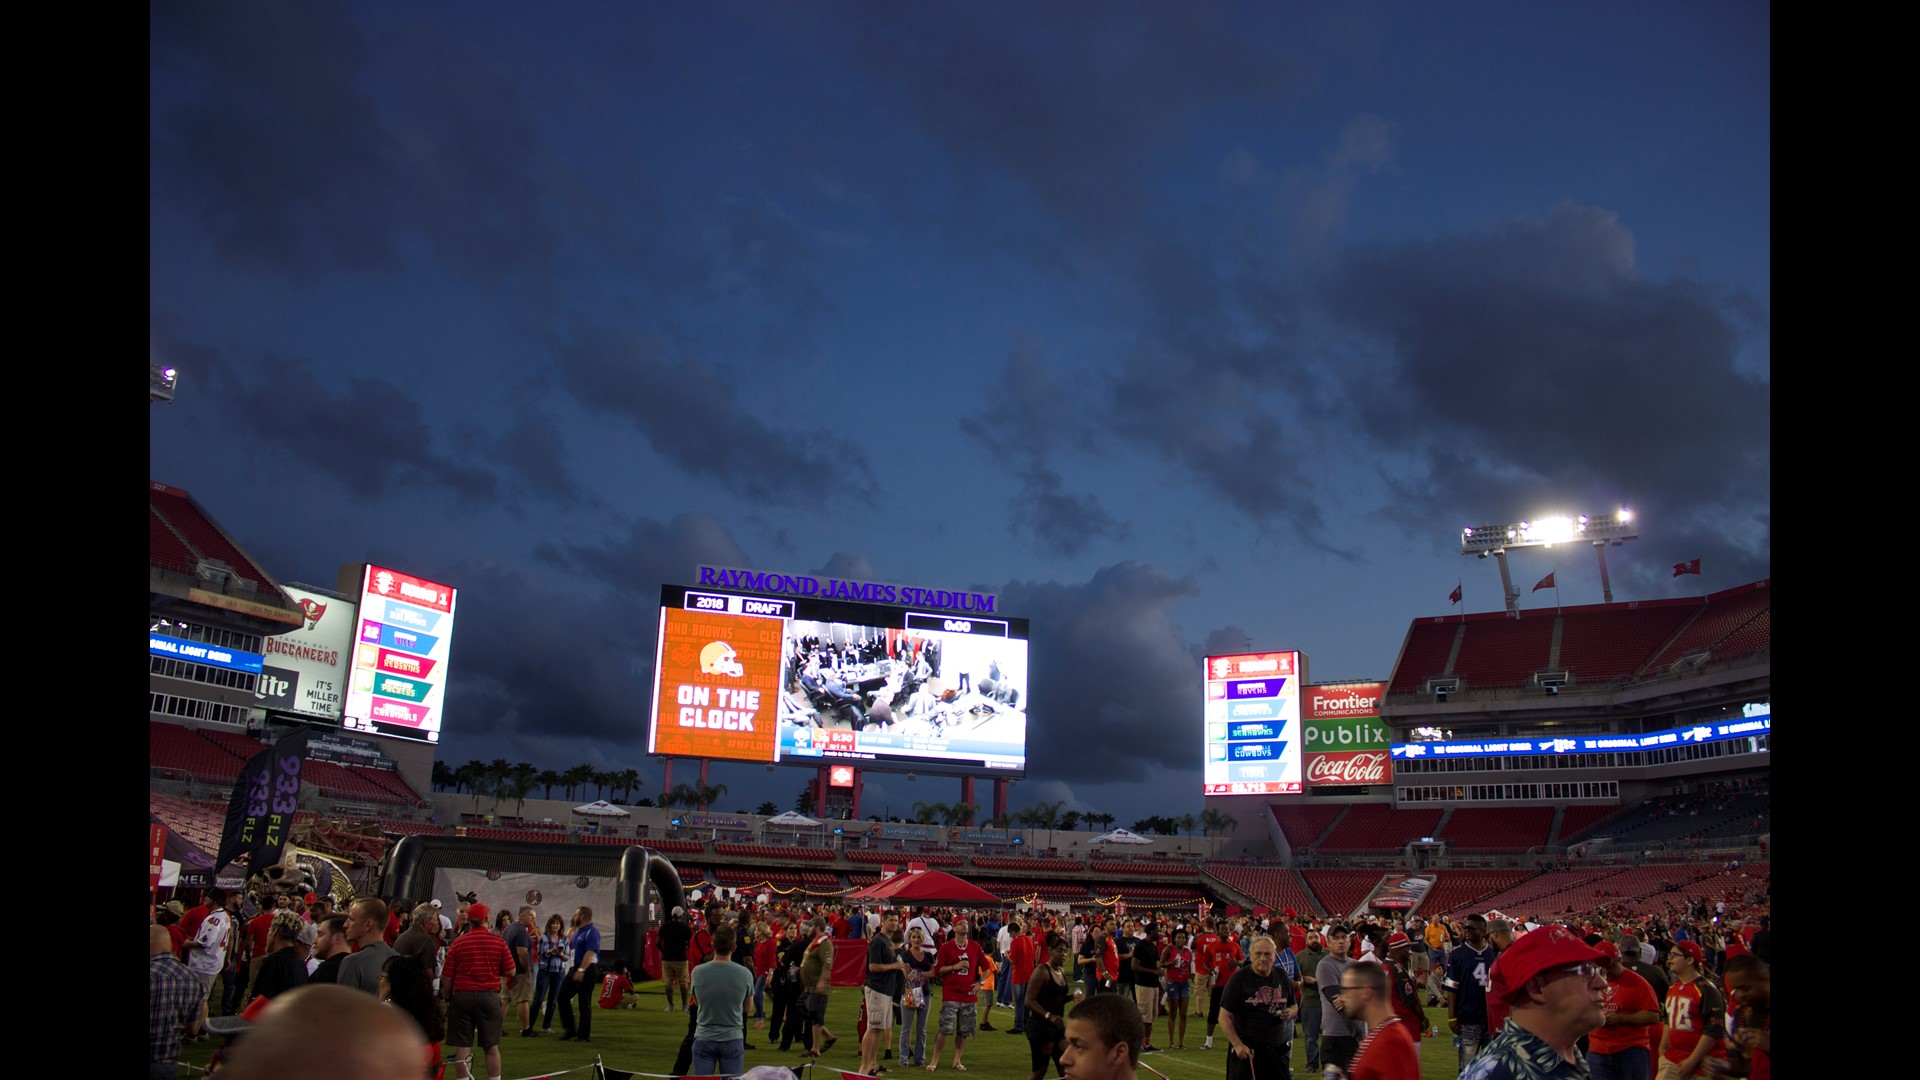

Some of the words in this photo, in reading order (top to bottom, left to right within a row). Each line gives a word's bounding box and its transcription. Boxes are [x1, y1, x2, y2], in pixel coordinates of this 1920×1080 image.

[699, 566, 819, 595] RAYMOND
[821, 579, 897, 603] JAMES
[900, 587, 996, 612] STADIUM
[438, 593, 448, 606] 1
[696, 597, 724, 610] 2018
[745, 601, 783, 615] DRAFT
[691, 624, 733, 640] BROWNS
[943, 620, 972, 633] 0:00
[279, 636, 308, 646] TAMPA
[394, 636, 416, 649] BILLS
[179, 644, 208, 658] LIGHT
[207, 650, 233, 663] BEER
[266, 637, 338, 667] BUCCANEERS
[383, 659, 421, 674] REDSKINS
[1279, 658, 1290, 671] 1
[255, 673, 290, 699] Lite
[316, 680, 333, 691] IT'S
[381, 682, 417, 698] PACKERS
[307, 689, 339, 704] MILLER
[677, 684, 710, 707] ON
[717, 688, 761, 711] THE
[1313, 694, 1377, 711] Frontier
[310, 701, 333, 713] TIME
[1313, 708, 1374, 717] COMMUNICATIONS
[679, 707, 755, 732] CLOCK
[1304, 723, 1385, 746] Publix
[1597, 738, 1639, 748] ORIGINAL
[1640, 736, 1659, 746] LIGHT
[1445, 744, 1484, 754] ORIGINAL
[1484, 743, 1509, 752] LIGHT
[1306, 753, 1388, 782] Coca-Cola
[272, 755, 301, 815] 93.3
[241, 817, 256, 844] FLZ
[265, 814, 282, 847] FLZ
[207, 917, 221, 927] 40
[1472, 962, 1488, 988] 4
[602, 978, 615, 999] 3
